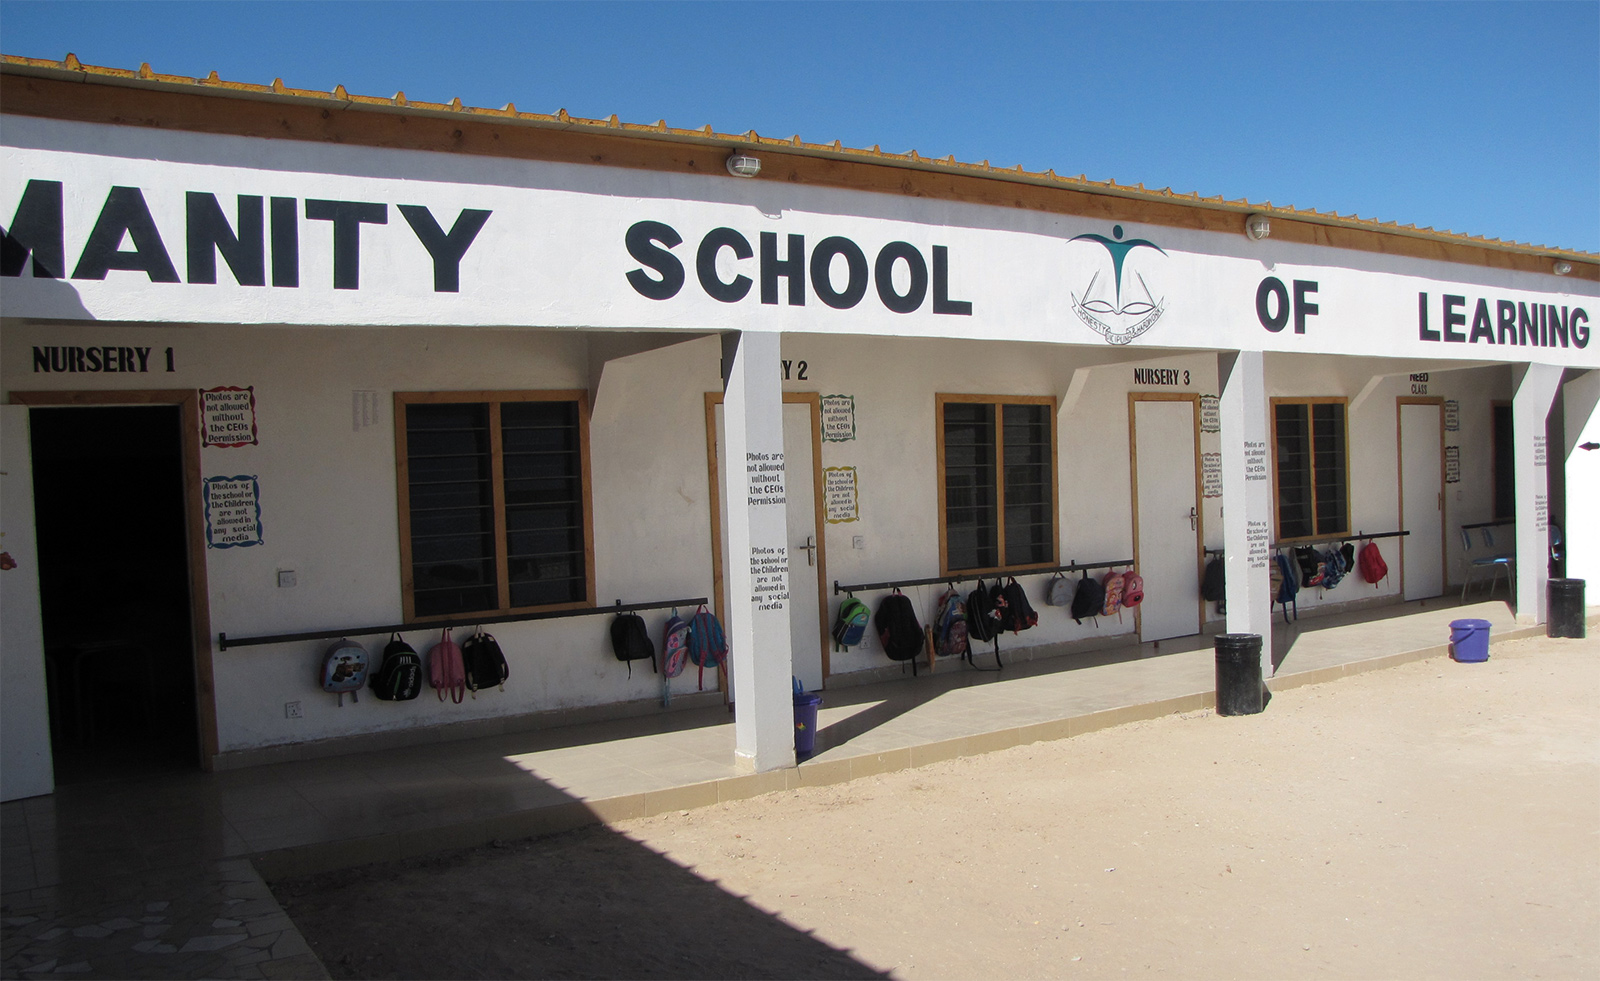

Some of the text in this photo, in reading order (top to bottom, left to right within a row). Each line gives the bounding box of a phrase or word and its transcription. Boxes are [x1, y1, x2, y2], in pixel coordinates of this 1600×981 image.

[625, 220, 972, 316] SCHOOL
[1255, 276, 1319, 334] OF
[1418, 292, 1590, 349] LEARNING
[1077, 307, 1106, 333] HONESTY
[32, 346, 176, 373] NURSERY 1
[798, 360, 808, 380] 2
[1134, 368, 1190, 386] NURSERY 3
[1411, 384, 1428, 394] CLASS
[210, 423, 248, 432] the CEOs
[208, 433, 251, 442] Permission
[746, 453, 769, 461] Photos
[747, 463, 785, 472] not allowed
[752, 474, 780, 483] without
[750, 486, 762, 494] the
[222, 491, 244, 499] school
[748, 496, 786, 506] Permission
[213, 524, 256, 535] any social
[222, 534, 249, 542] media
[778, 547, 785, 556] of
[762, 565, 788, 574] Children
[755, 583, 778, 592] allowed
[768, 592, 789, 601] social
[758, 602, 782, 611] media
